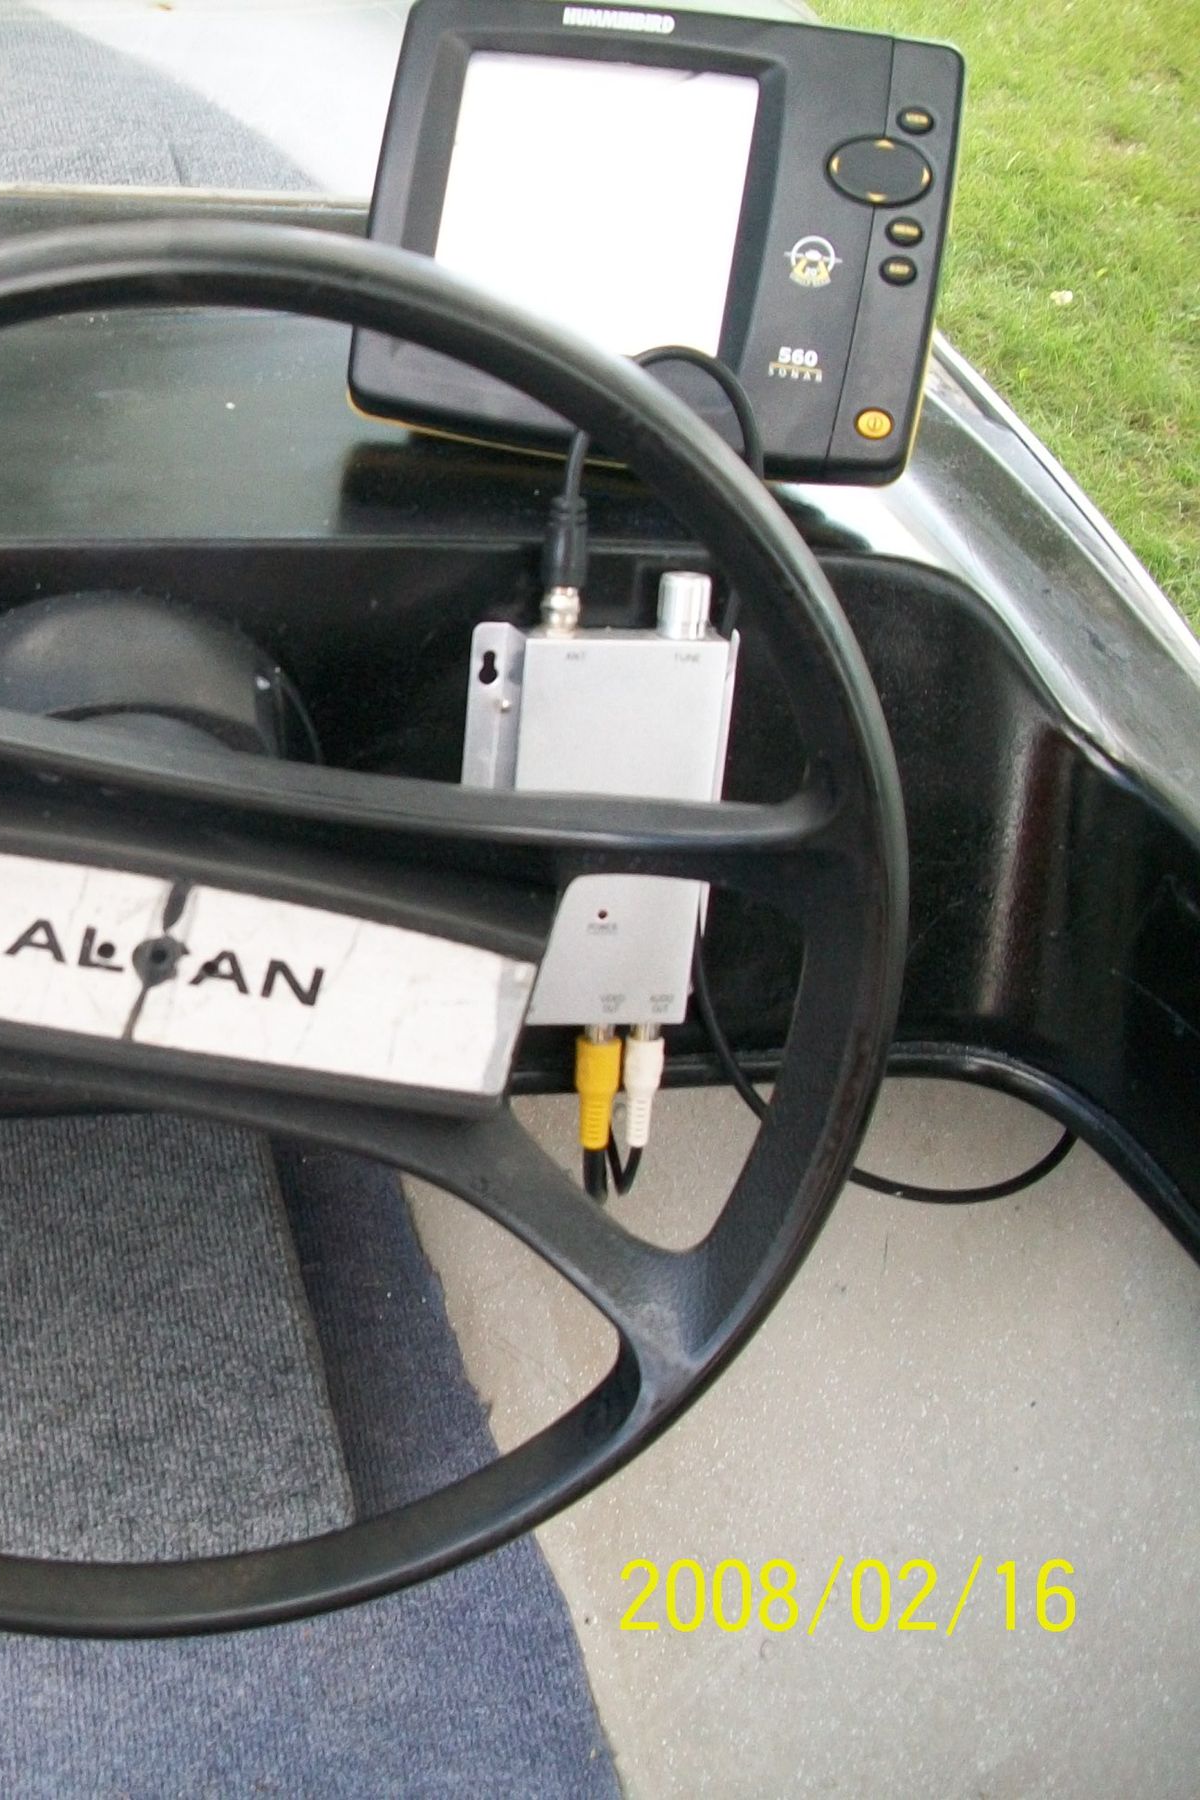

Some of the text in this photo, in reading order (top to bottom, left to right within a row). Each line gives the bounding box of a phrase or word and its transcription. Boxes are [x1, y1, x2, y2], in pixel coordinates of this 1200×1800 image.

[778, 346, 818, 368] 560
[768, 366, 823, 383] SONAR
[674, 652, 701, 663] TUNE
[4, 918, 325, 1007] ALAN
